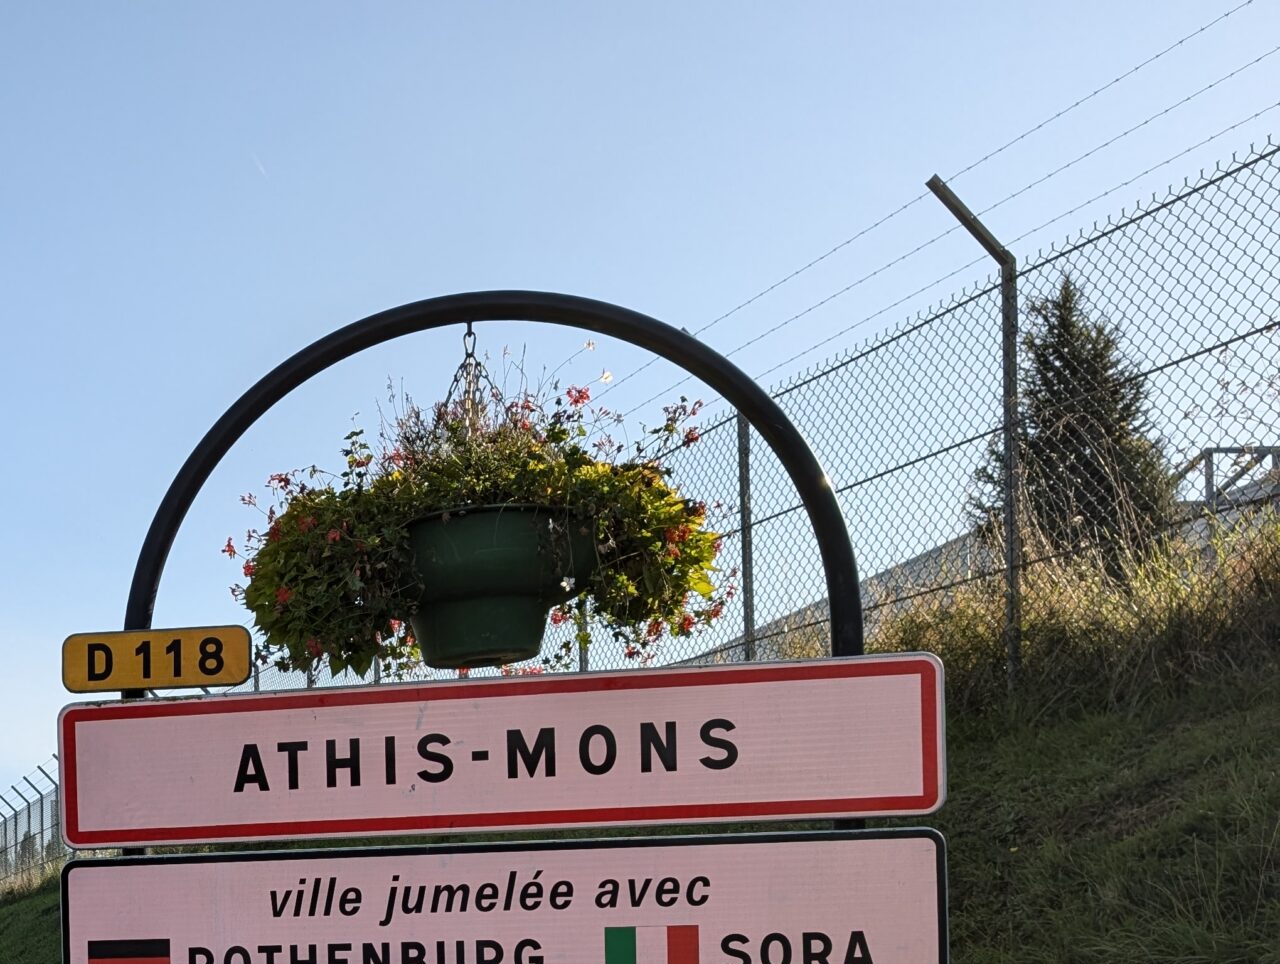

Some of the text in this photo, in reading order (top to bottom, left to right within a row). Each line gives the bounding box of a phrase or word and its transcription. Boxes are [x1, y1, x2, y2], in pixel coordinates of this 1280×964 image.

[88, 637, 224, 681] D 118
[233, 718, 738, 793] ATHIS-MONS
[269, 869, 711, 926] ville jumelée avec
